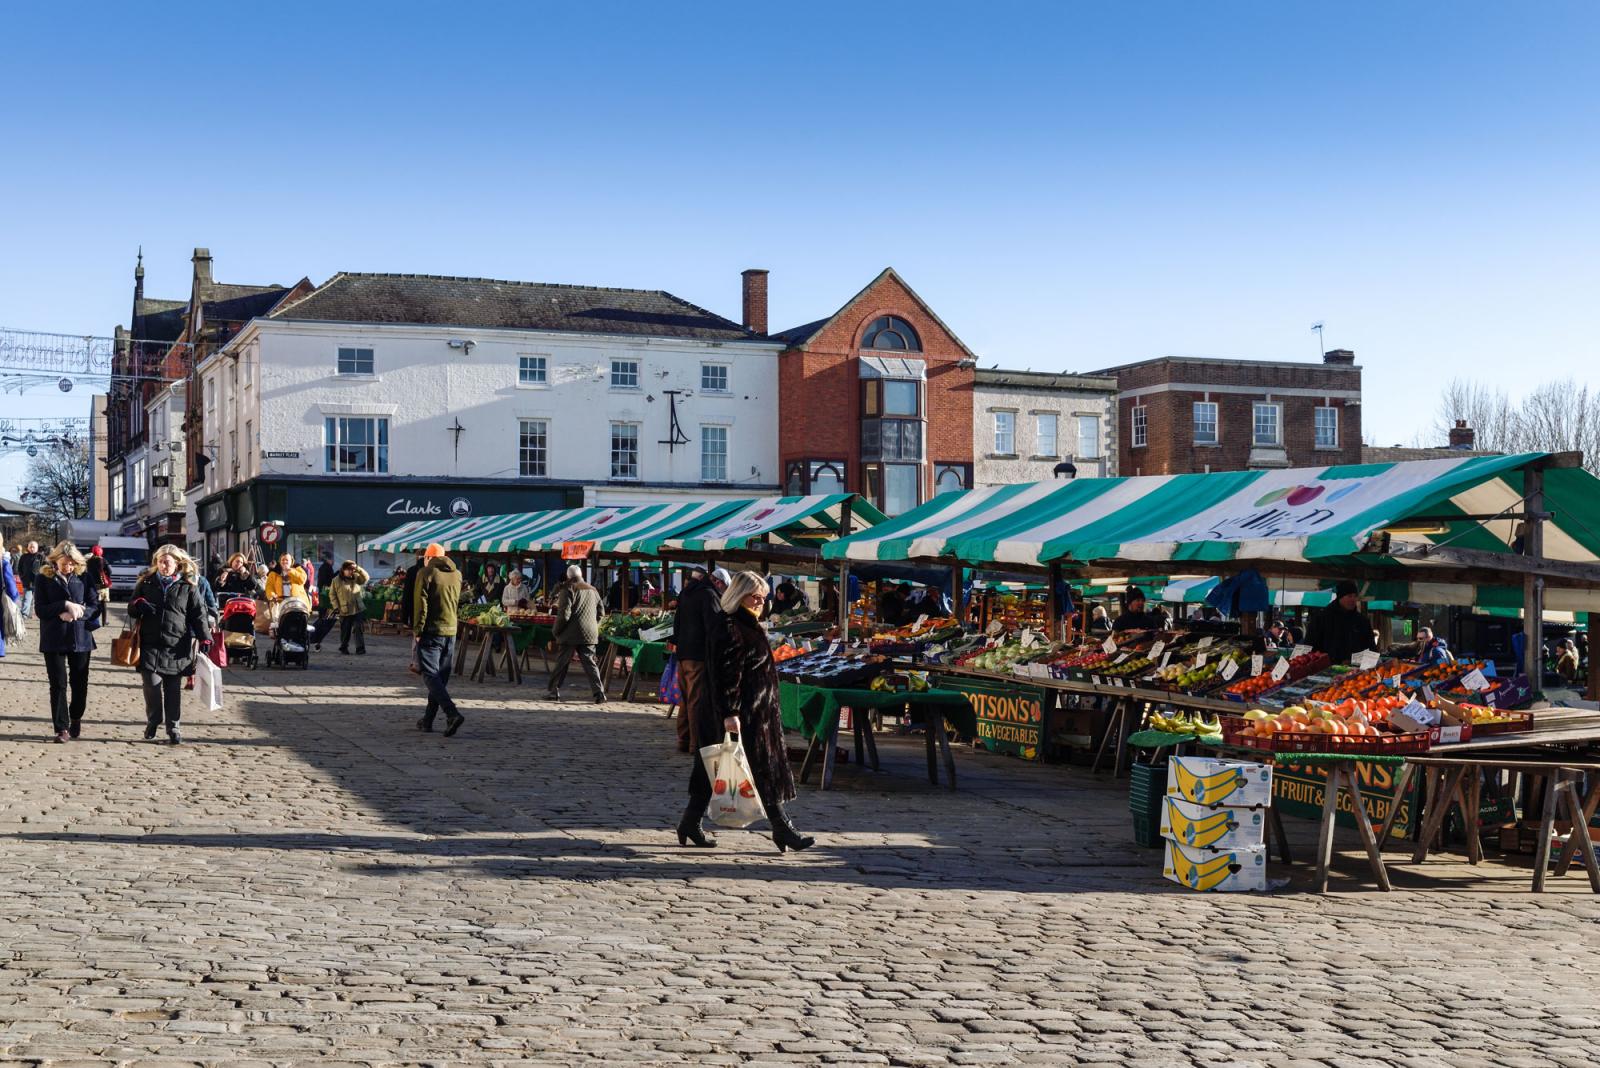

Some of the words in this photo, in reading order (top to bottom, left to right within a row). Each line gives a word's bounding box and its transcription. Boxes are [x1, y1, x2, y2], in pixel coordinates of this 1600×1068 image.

[0, 335, 64, 365] elcome
[386, 498, 442, 515] Clarks
[961, 691, 1030, 724] OTSON'S
[1281, 780, 1316, 804] FRUIT
